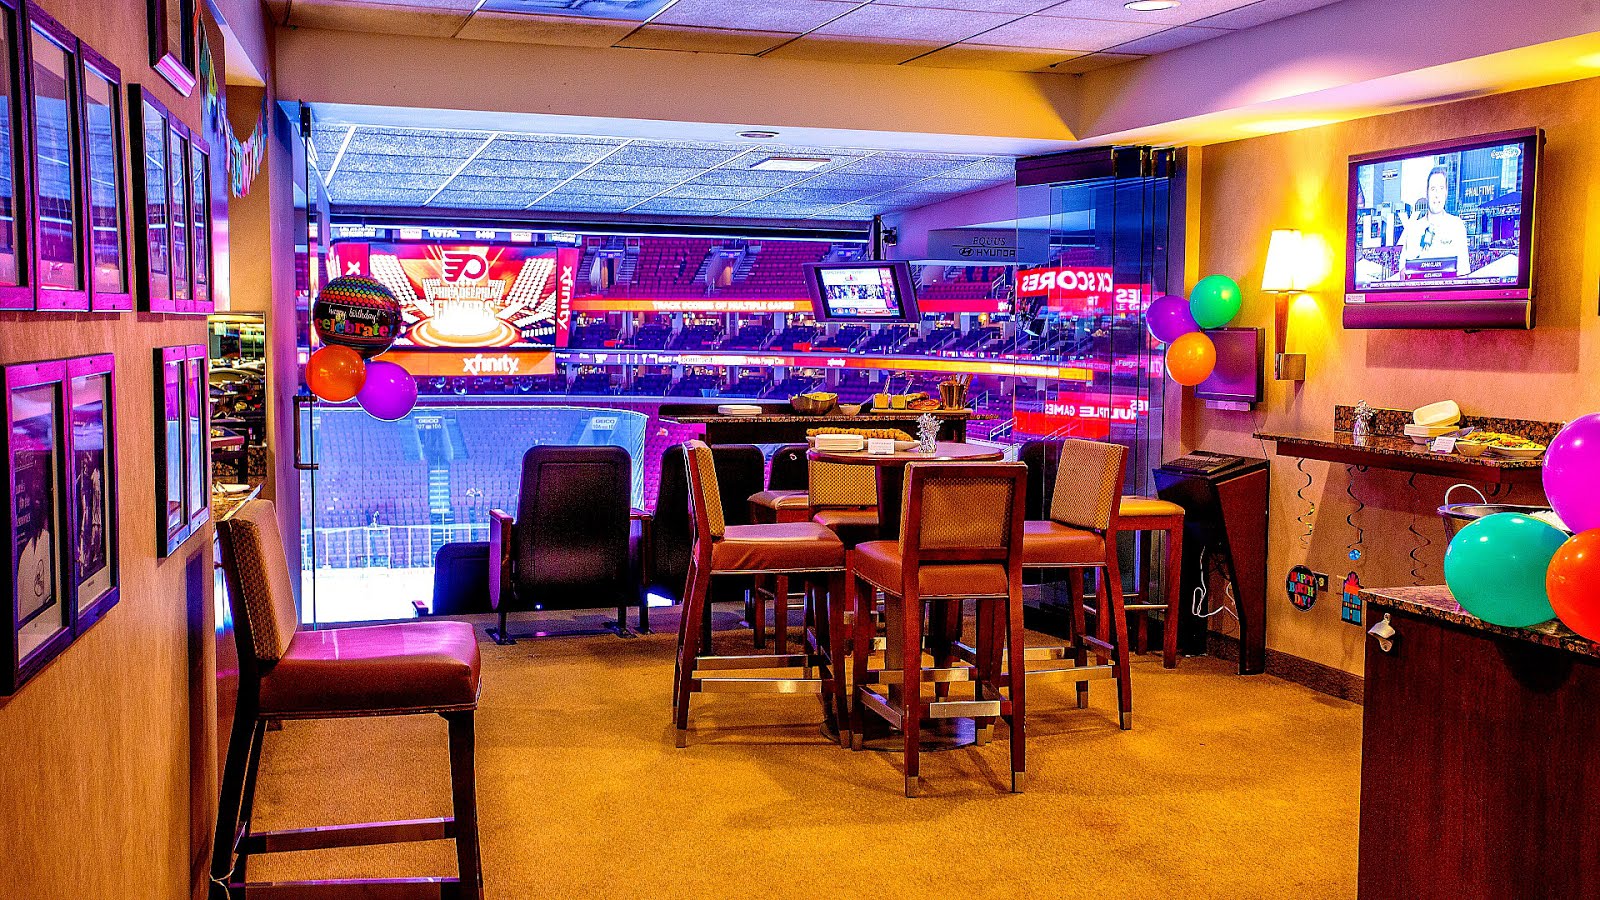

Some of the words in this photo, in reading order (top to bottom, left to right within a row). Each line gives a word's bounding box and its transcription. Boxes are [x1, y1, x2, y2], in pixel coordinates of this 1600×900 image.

[428, 229, 460, 238] TOTAL
[973, 236, 1006, 247] EQUUS
[976, 248, 1017, 257] HYUNDA
